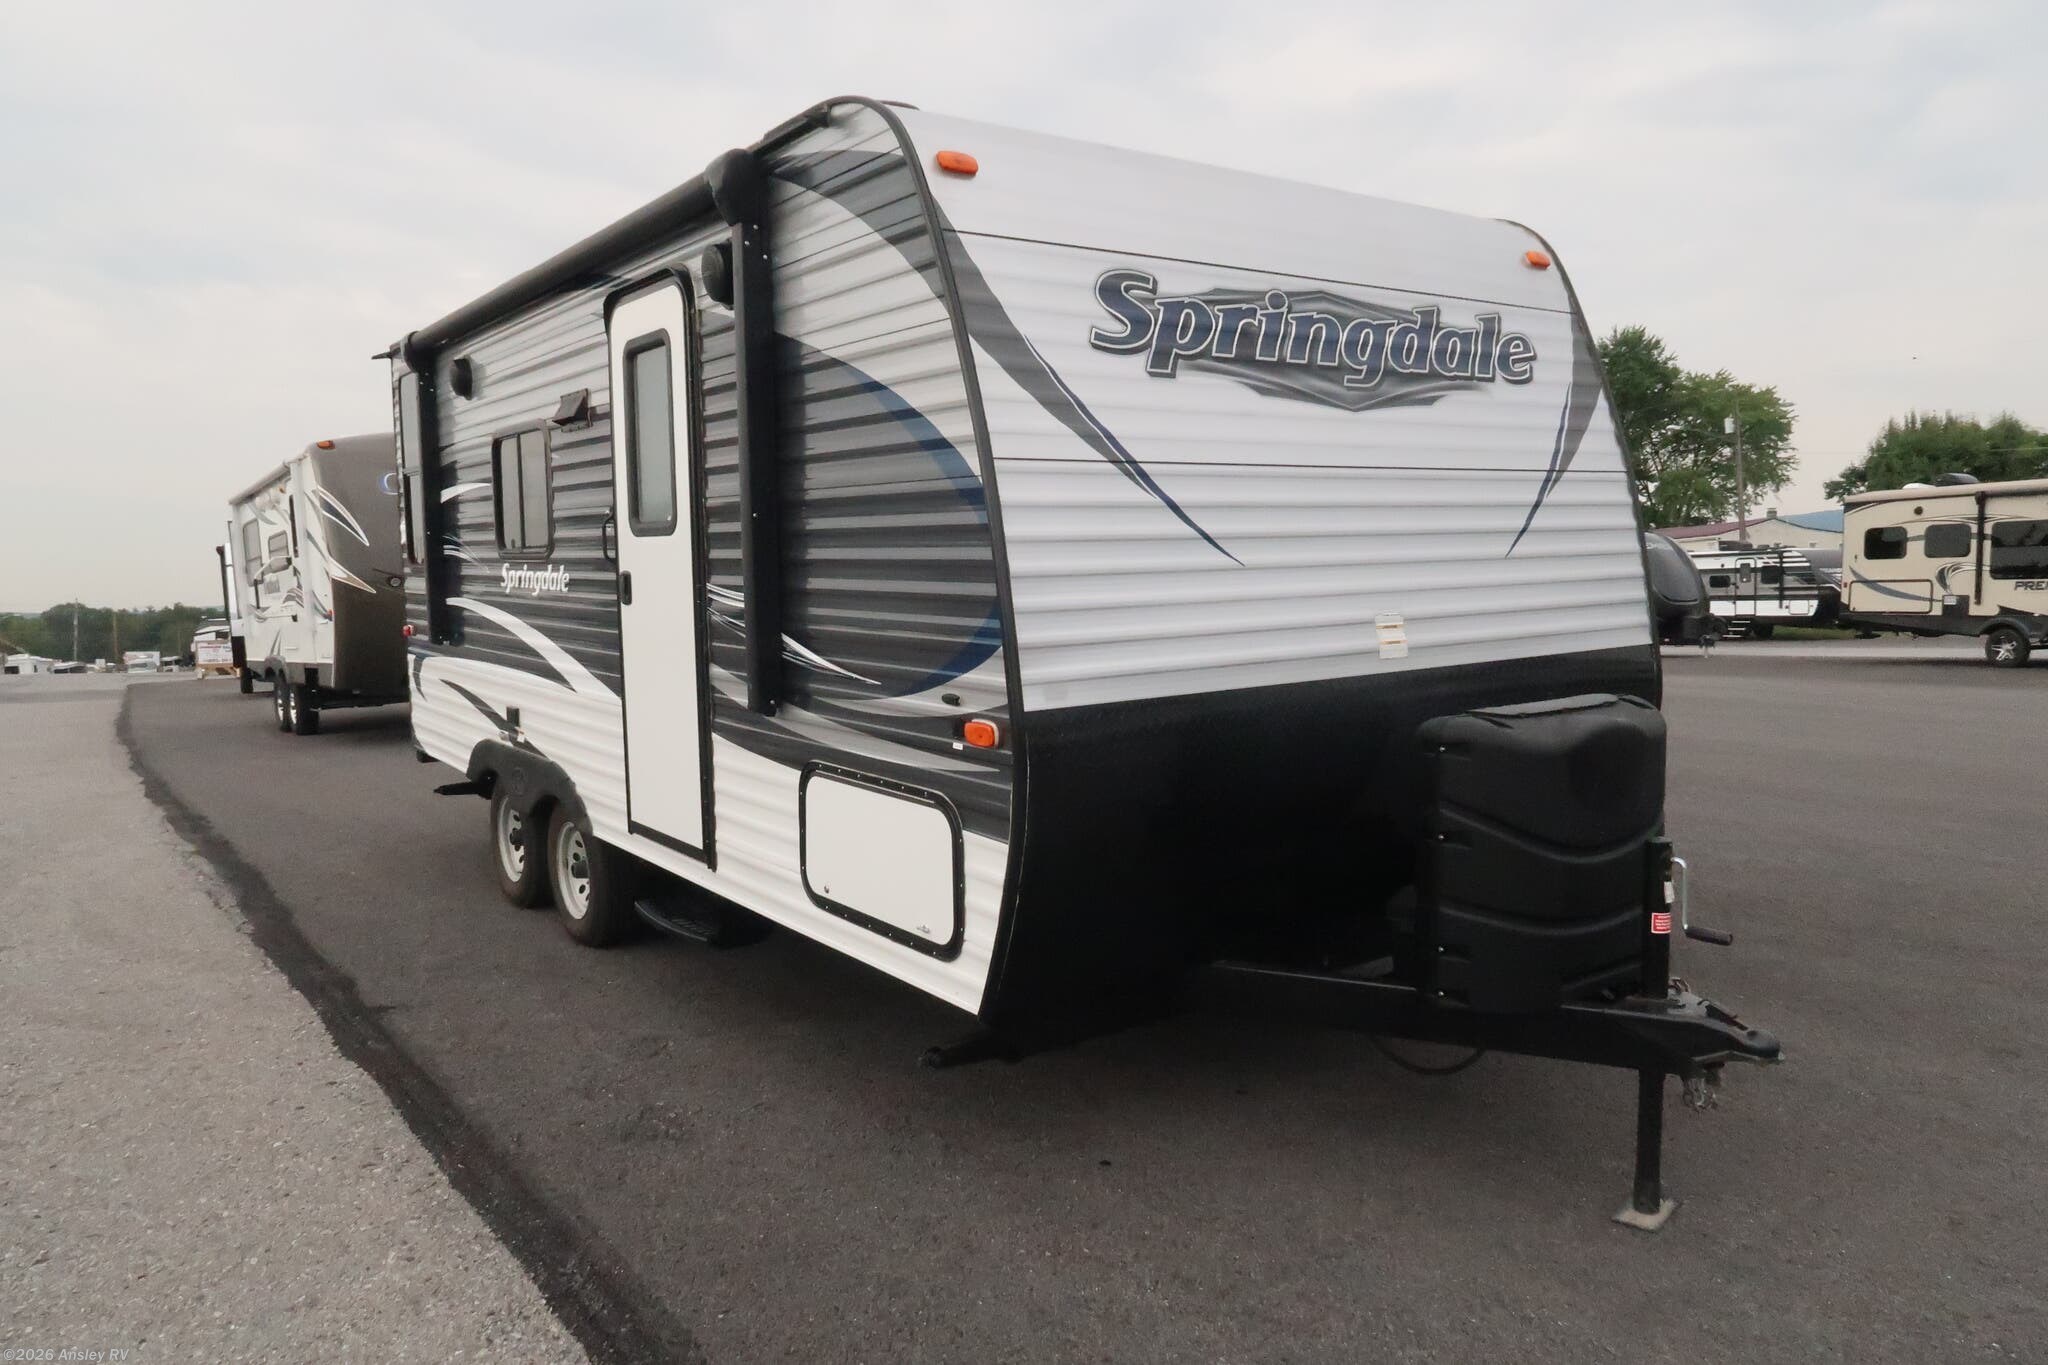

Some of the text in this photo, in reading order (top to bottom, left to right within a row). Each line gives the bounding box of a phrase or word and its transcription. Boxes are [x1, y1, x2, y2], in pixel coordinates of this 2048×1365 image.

[1089, 268, 1537, 388] Springdale
[501, 562, 570, 596] Springdale
[2014, 581, 2048, 591] PRE
